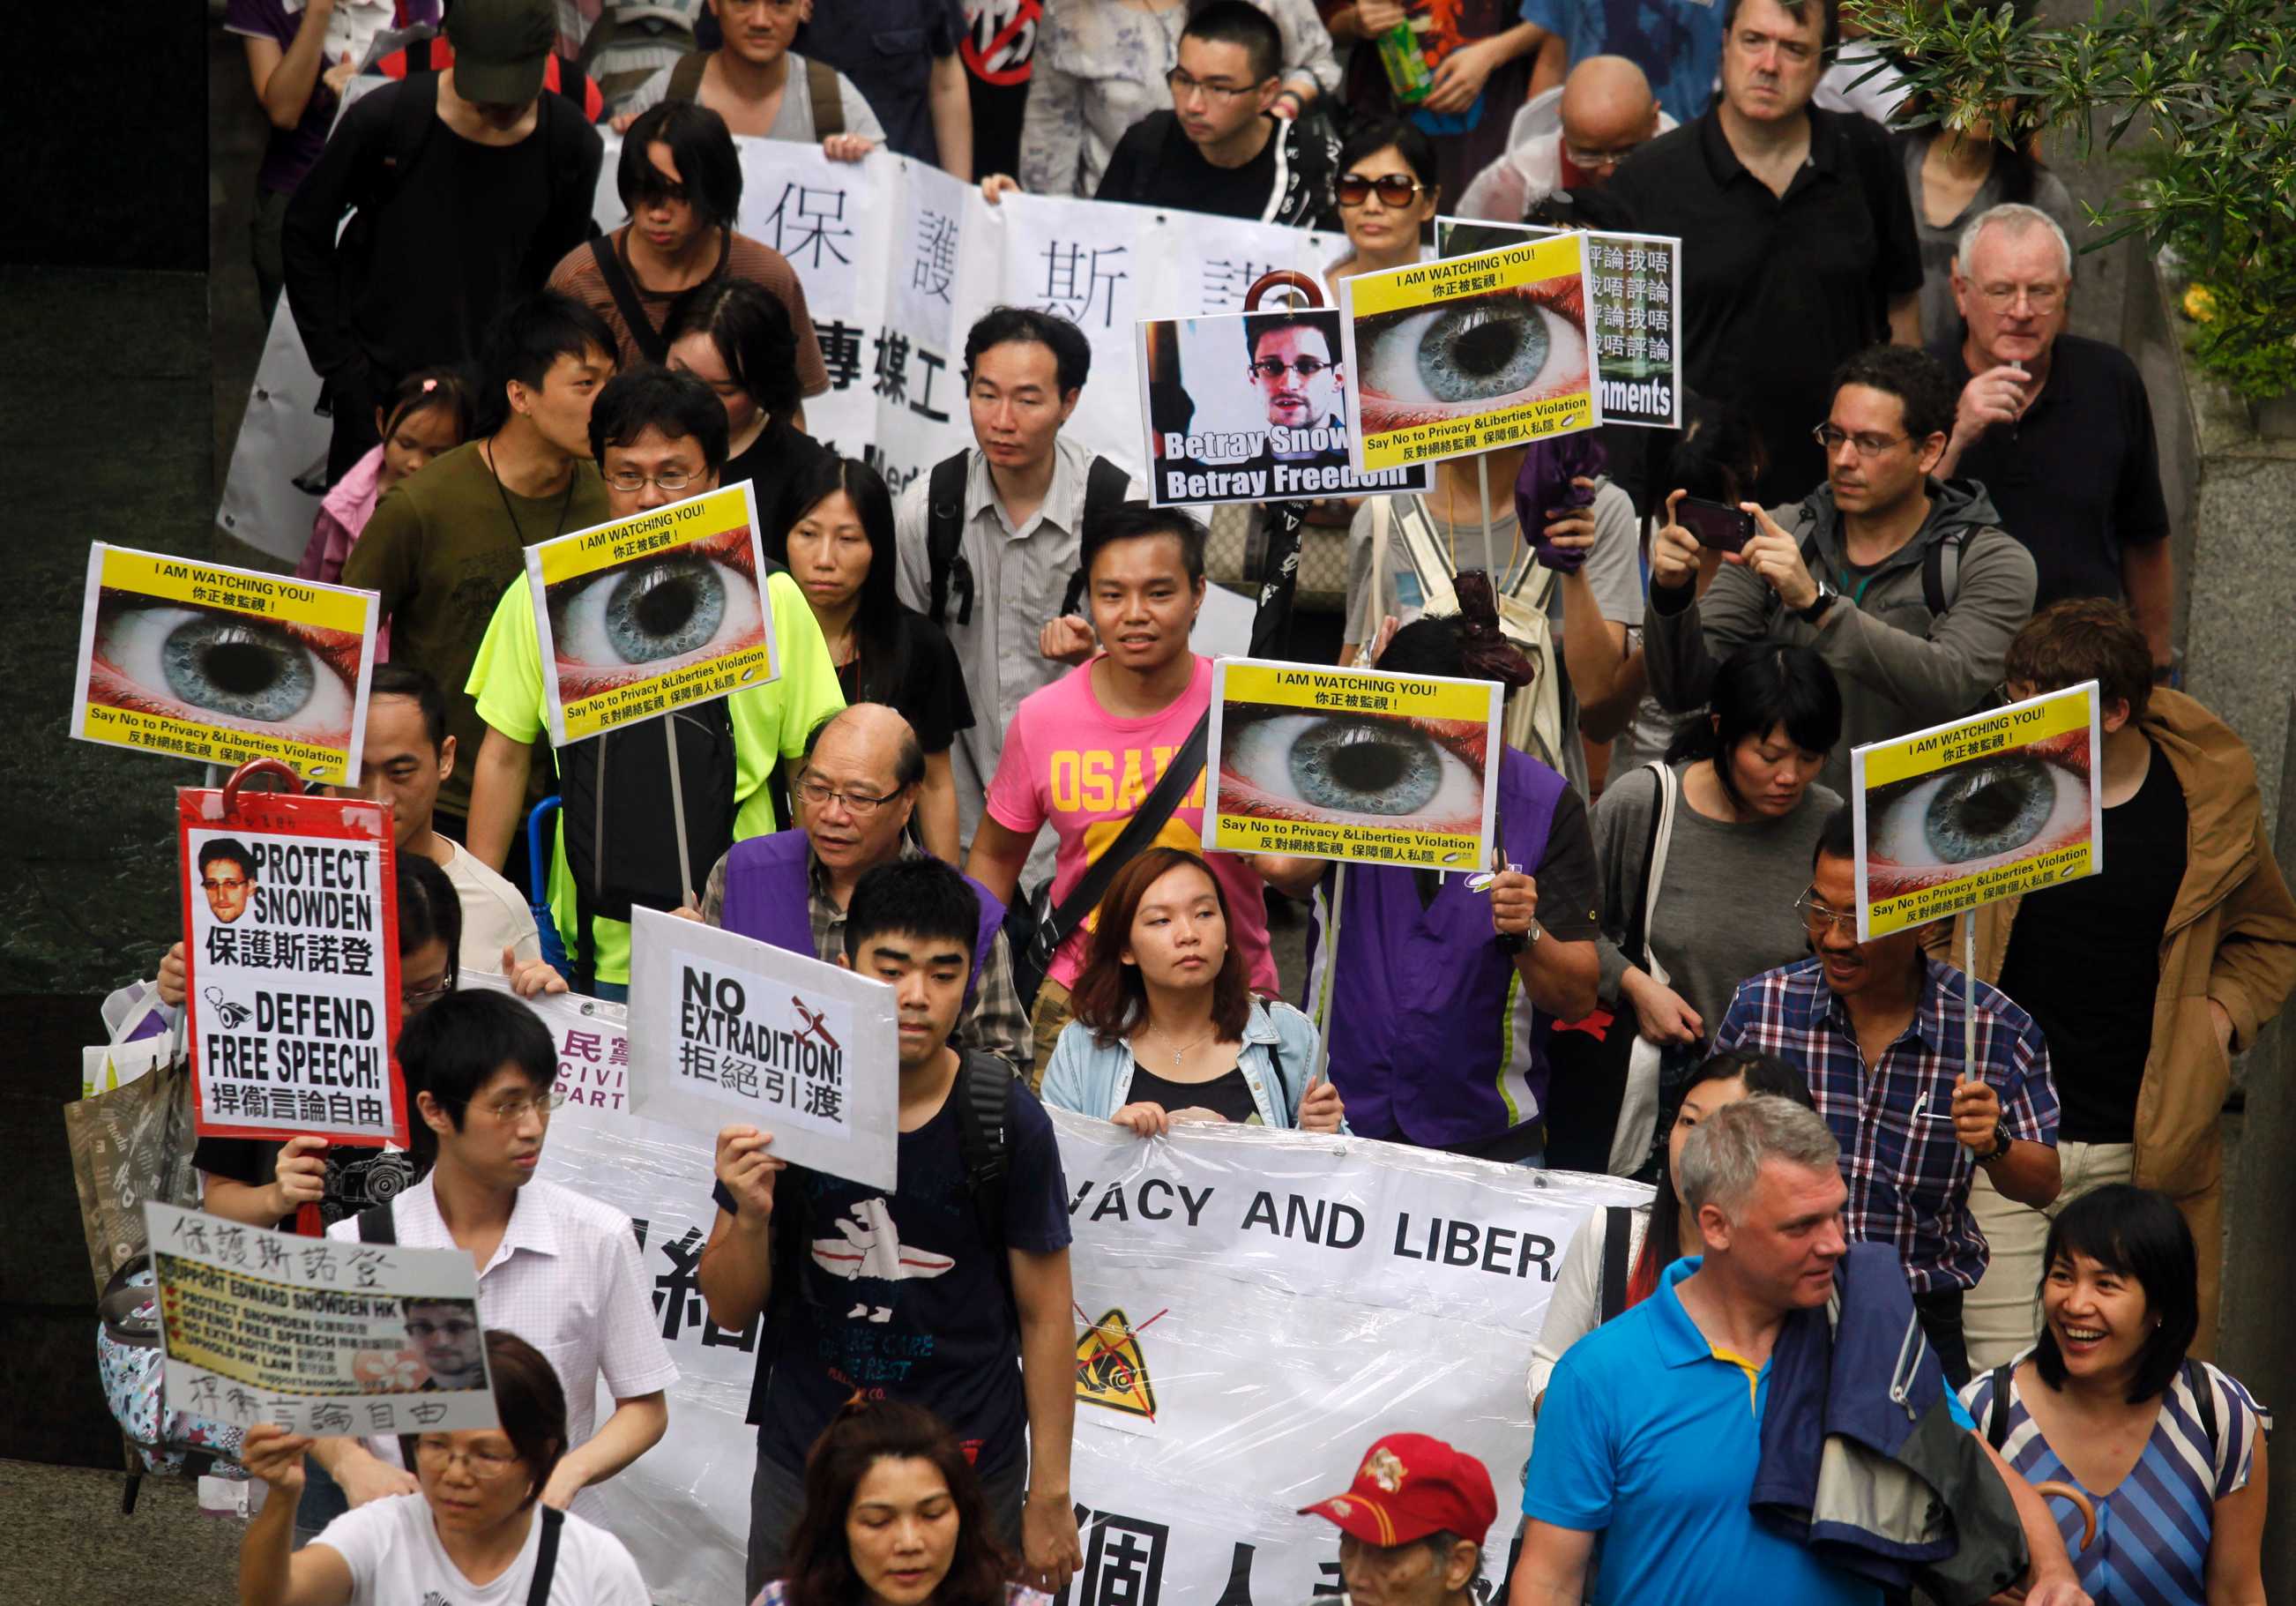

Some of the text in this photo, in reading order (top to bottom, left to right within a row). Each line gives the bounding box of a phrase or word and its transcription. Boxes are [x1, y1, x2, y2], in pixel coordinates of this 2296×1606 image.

[1397, 249, 1534, 287] I AM WATCHING YOU!
[1165, 430, 1264, 460] Betray
[1368, 438, 1389, 450] Say
[1392, 433, 1409, 444] No
[1413, 431, 1425, 441] to
[1428, 422, 1471, 438] Privacy
[1535, 399, 1586, 416] Violation
[1167, 469, 1266, 499] Betray
[579, 504, 704, 551] I AM WATCHING YOU!
[154, 563, 315, 602] I AM WATCHING YOU!
[567, 706, 586, 719] Say
[589, 699, 605, 712] No
[607, 696, 618, 706] to
[620, 683, 659, 702] Privacy
[716, 651, 764, 671] Violation
[1277, 672, 1436, 696] I AM WATCHING YOU!
[91, 707, 116, 724] Say
[119, 713, 138, 726] No
[142, 718, 156, 729] to
[160, 721, 208, 741] Privacy
[283, 743, 342, 765] Violation
[1909, 706, 2045, 755] I AM WATCHING YOU!
[1222, 818, 1247, 833] Say
[1250, 821, 1270, 833] No
[1273, 824, 1287, 834] to
[1291, 824, 1339, 840] Privacy
[1414, 834, 1474, 849] Violation
[251, 843, 369, 892] PROTECT
[1873, 904, 1894, 916] Say
[1897, 898, 1914, 910] No
[1917, 894, 1929, 904] to
[1932, 881, 1973, 900] Privacy
[2037, 848, 2087, 869] Violation
[254, 885, 372, 931] SNOWDEN
[205, 925, 374, 976] 保護斯諾登
[682, 965, 746, 1016] NO
[256, 991, 374, 1041] DEFEND
[207, 1034, 380, 1089] FREE SPEECH!
[682, 1001, 842, 1086] EXTRADITION!
[679, 1042, 843, 1124] 拒絕引渡
[1241, 1191, 1365, 1250] AND
[1393, 1212, 1562, 1282] LIBER
[230, 1279, 288, 1307] EDWARD
[293, 1294, 369, 1316] SNOWDEN
[373, 1301, 398, 1318] HK
[238, 1321, 272, 1340] FREE
[277, 1329, 336, 1348] SPEECH
[262, 1356, 292, 1371] LAW
